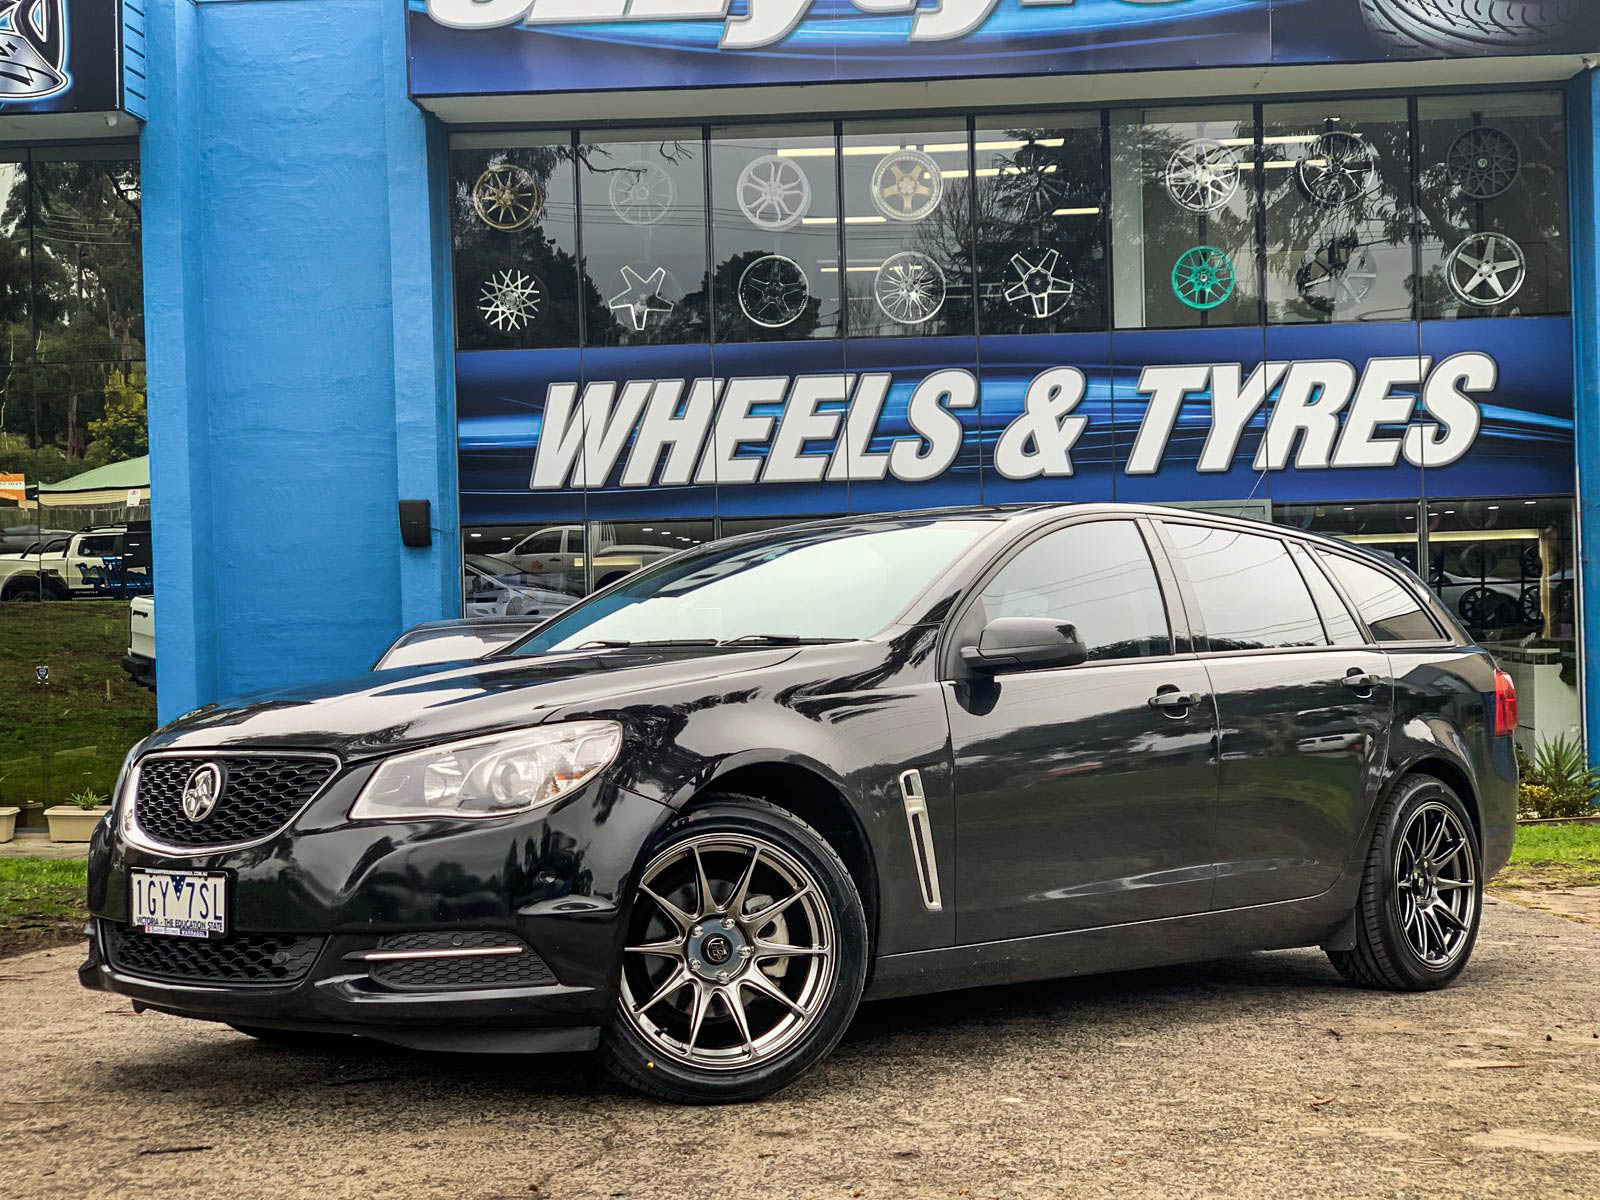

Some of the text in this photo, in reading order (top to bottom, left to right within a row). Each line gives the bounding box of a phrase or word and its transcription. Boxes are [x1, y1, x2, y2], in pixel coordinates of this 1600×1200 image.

[530, 351, 1497, 490] WHEELS & TYRES
[136, 916, 159, 926] VICTORIA
[164, 918, 175, 928] THE
[175, 919, 206, 930] EDUCATION
[207, 921, 223, 931] STATE
